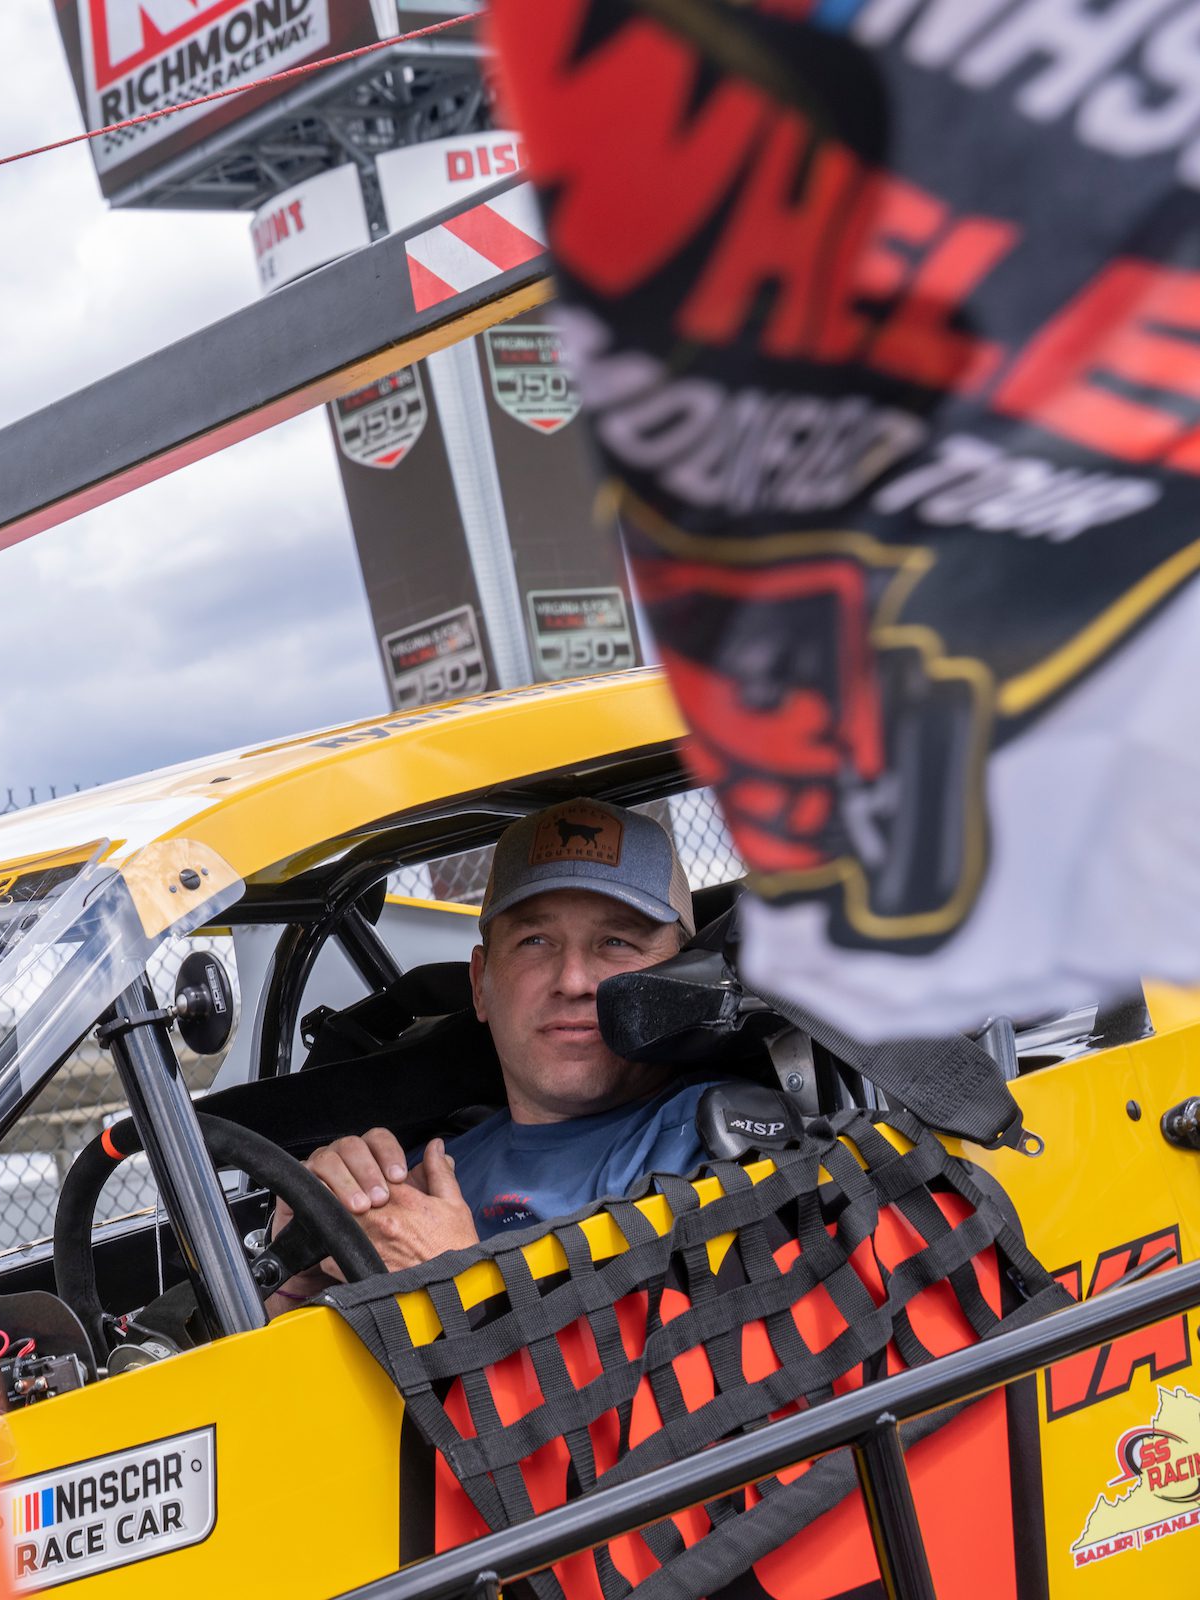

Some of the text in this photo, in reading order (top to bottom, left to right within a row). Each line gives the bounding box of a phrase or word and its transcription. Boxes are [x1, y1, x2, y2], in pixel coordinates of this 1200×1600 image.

[211, 14, 312, 90] RACEWAY
[851, 0, 1200, 188] NAS
[254, 199, 305, 257] UNT
[309, 700, 461, 749] Ryan
[744, 1120, 785, 1136] ISP
[1139, 1437, 1171, 1469] SS
[56, 1452, 183, 1524] NASCAR
[17, 1502, 183, 1576] RACE CAR
[1075, 1535, 1134, 1566] SADLER
